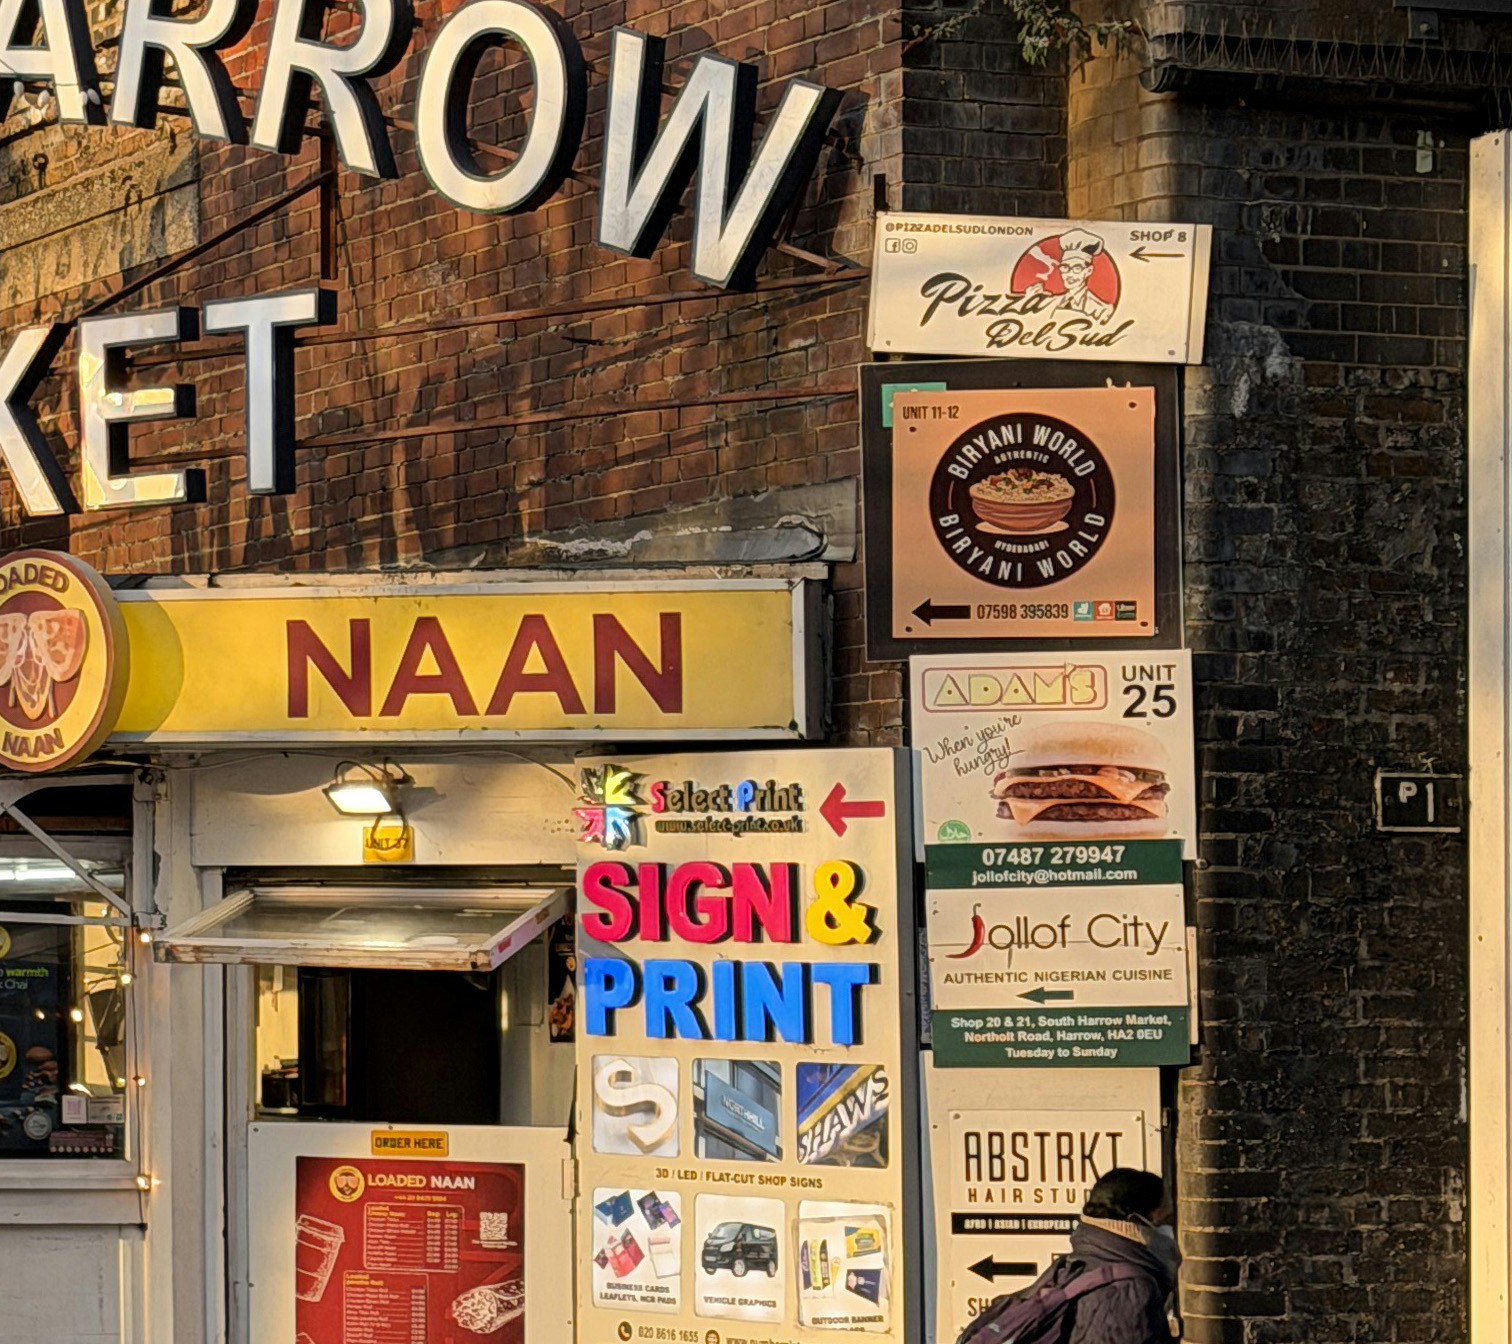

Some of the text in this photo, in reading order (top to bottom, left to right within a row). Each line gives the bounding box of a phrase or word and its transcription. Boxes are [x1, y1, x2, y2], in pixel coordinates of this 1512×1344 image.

[885, 222, 1187, 243] @PIZZADELSUDLONDON SHOP 8
[920, 271, 1049, 327] Pizza
[985, 318, 1135, 352] Del Sud
[902, 405, 960, 420] UNIT 11-12
[947, 423, 1096, 479] BIRYANI WORLD
[939, 513, 1105, 582] BIRYANI WORLD
[976, 602, 1069, 621] 07598 395839
[285, 610, 683, 719] NAAN
[1121, 664, 1177, 683] UNIT
[933, 661, 1097, 707] ADAM'S
[1121, 685, 1178, 718] 25
[2, 727, 64, 758] NAAN
[923, 736, 973, 764] When
[650, 779, 803, 813] Select Print
[981, 845, 1126, 866] 07487 279947
[971, 868, 1137, 886] jollofcity@hotmail.com
[581, 860, 882, 945] SIGN &
[945, 903, 1169, 960] Jollof City
[943, 968, 1173, 985] AUTHENTIC NIGERIAN CUISINE
[583, 957, 882, 1046] PRINT
[951, 1014, 1172, 1030] Shop 20 & 21, South Harrow Market,
[964, 1029, 1134, 1043] Northolt Road, Harrow, HA2
[1005, 1046, 1118, 1059] Tuesday to Sunday
[375, 1137, 444, 1149] ORDER HERE
[964, 1131, 1123, 1182] ABSTRKT
[367, 1173, 475, 1190] LOADED NAAN
[655, 1169, 823, 1188] 3D LED FLAT-CUT SHOP SIGNS
[968, 1188, 1023, 1203] HAIR
[645, 1284, 670, 1294] CARDS
[703, 1296, 777, 1308] VEHICLE GRAPHICS
[638, 1326, 654, 1338] 020
[679, 1329, 699, 1343] 1655
